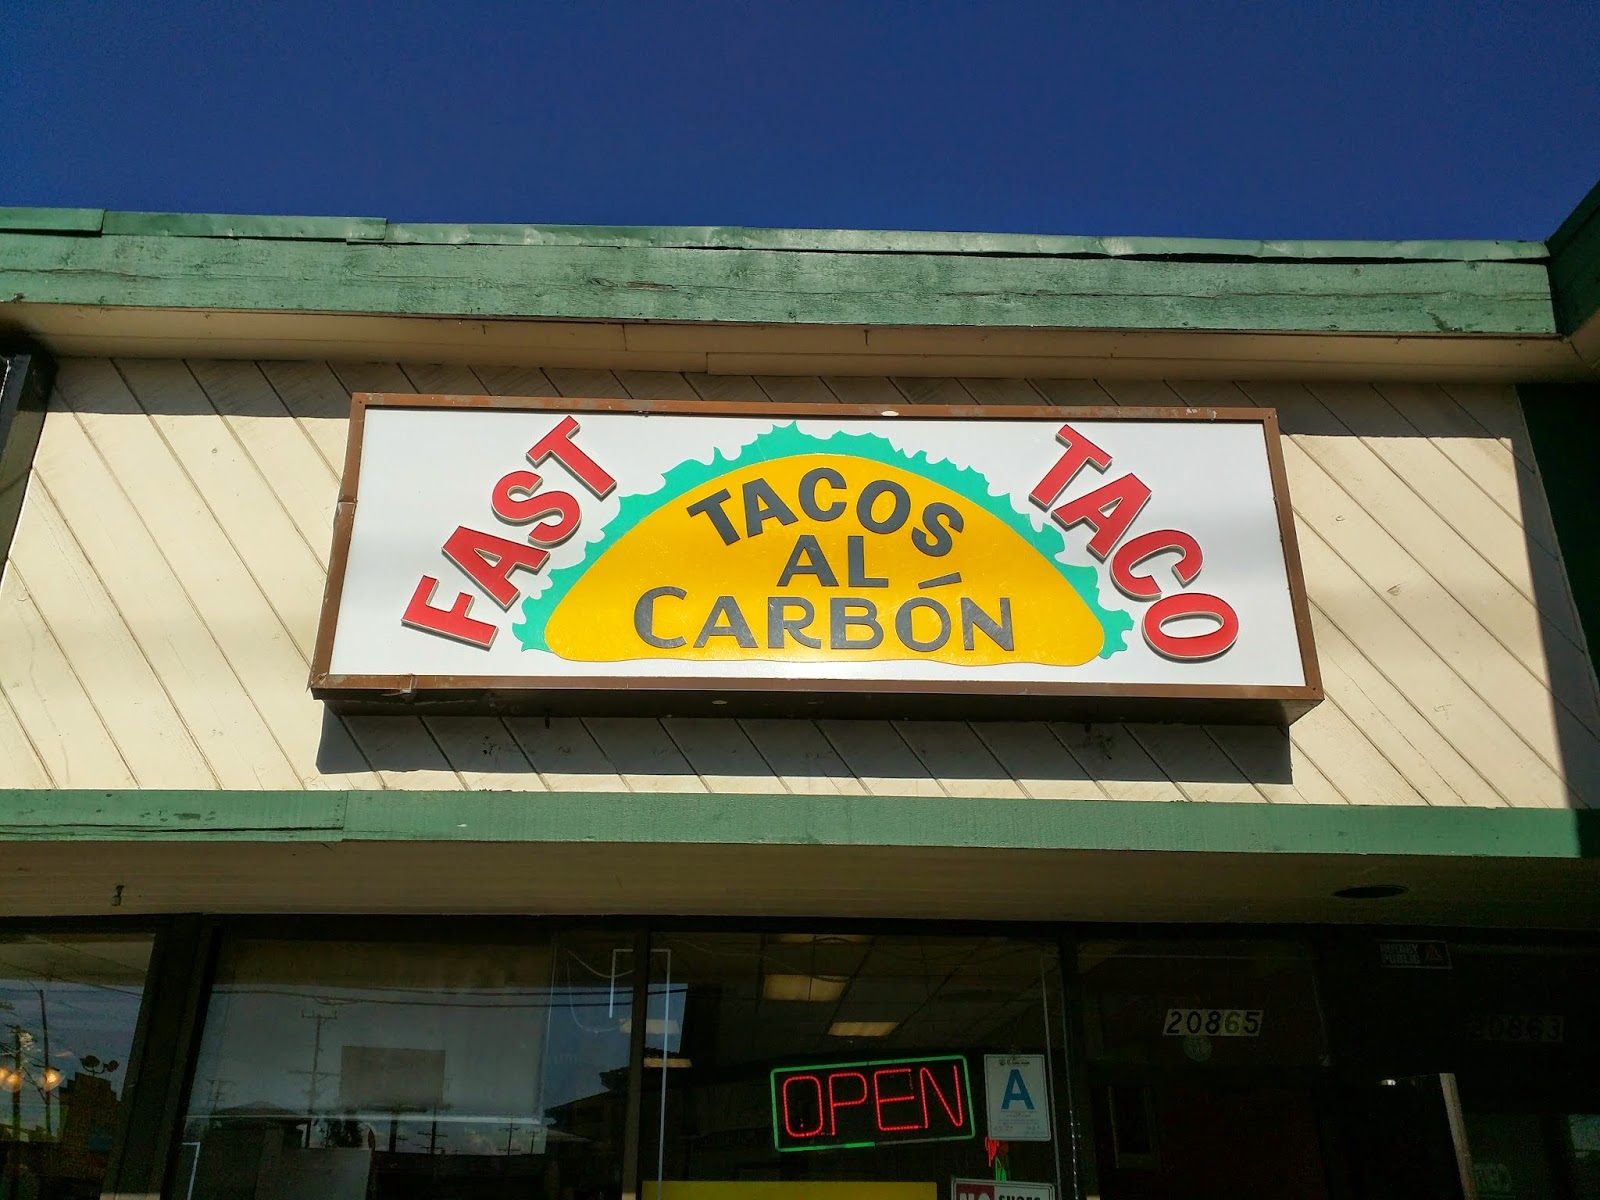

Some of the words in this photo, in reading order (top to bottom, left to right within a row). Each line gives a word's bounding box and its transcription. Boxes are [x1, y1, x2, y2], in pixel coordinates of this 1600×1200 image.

[401, 415, 617, 650] FAST
[1028, 424, 1239, 660] TACO
[686, 467, 964, 557] TACOS
[776, 534, 889, 588] AL
[633, 572, 1014, 652] CARBÓN
[1166, 1010, 1260, 1034] 20865
[782, 1065, 964, 1138] OPEN
[1001, 1069, 1035, 1110] A
